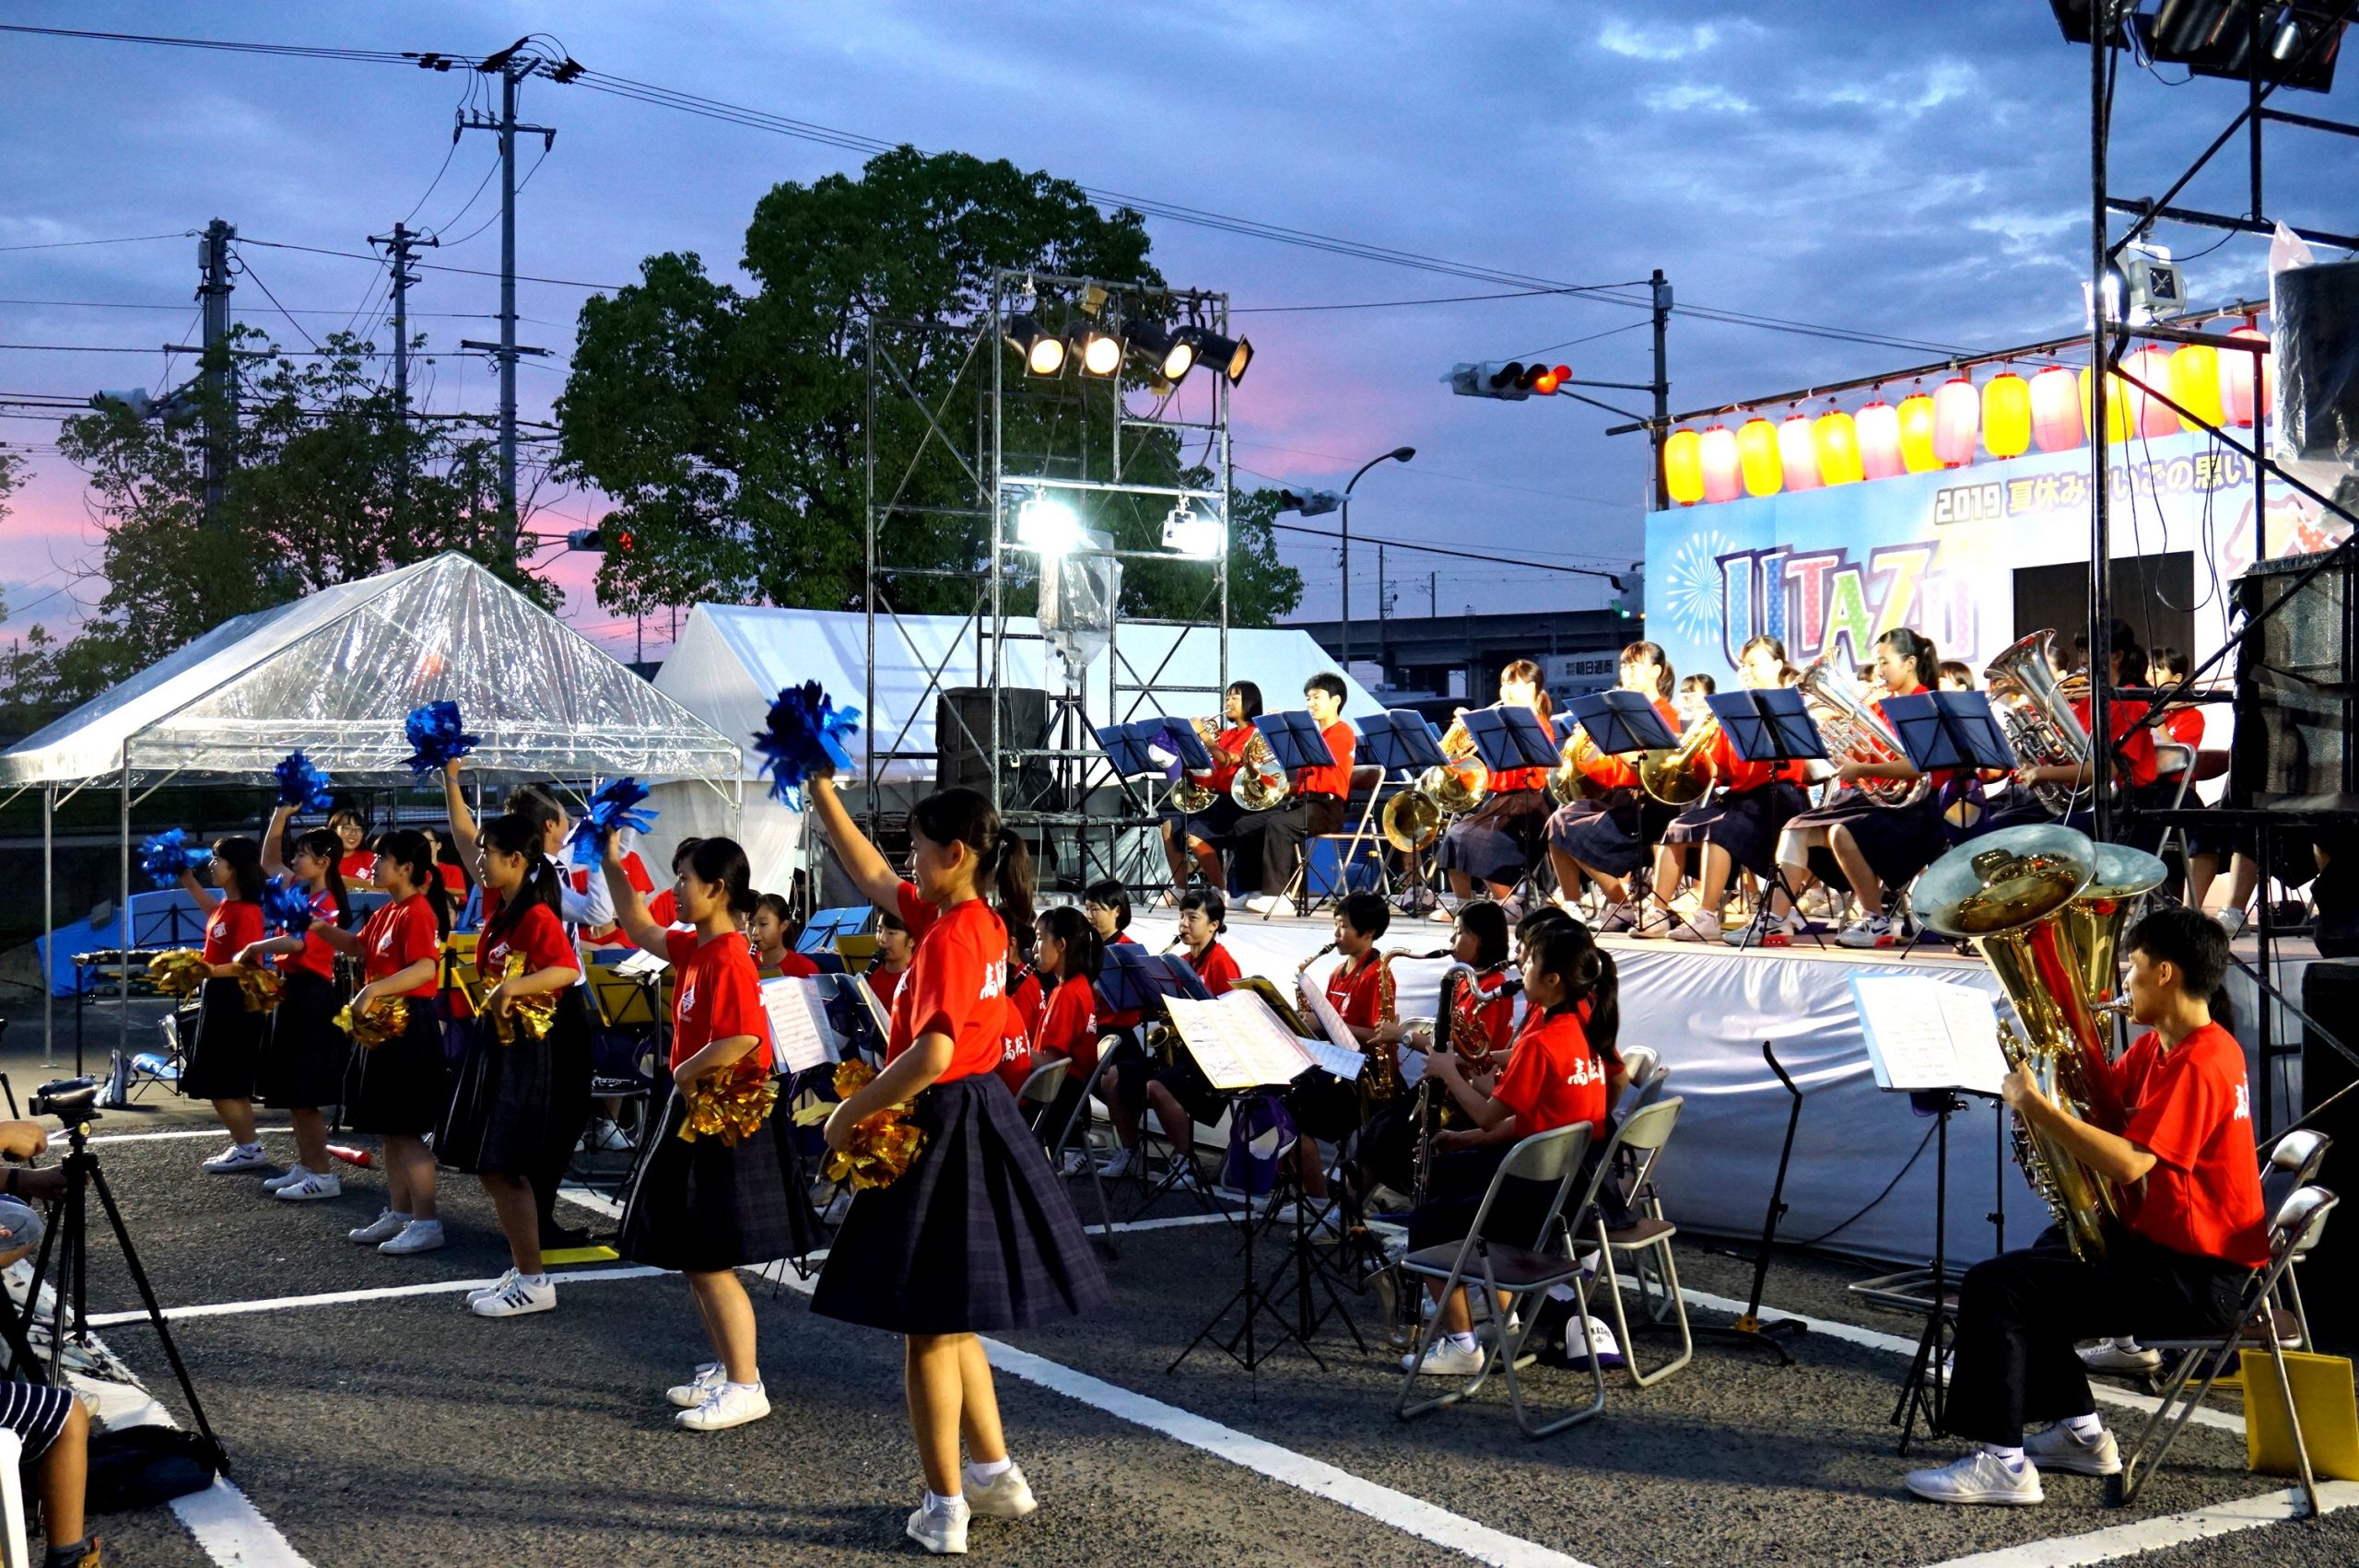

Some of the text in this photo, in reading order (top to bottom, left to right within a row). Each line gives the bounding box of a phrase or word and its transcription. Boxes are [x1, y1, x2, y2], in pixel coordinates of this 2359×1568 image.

[1935, 443, 2283, 525] 2019 夏休みいごの思い
